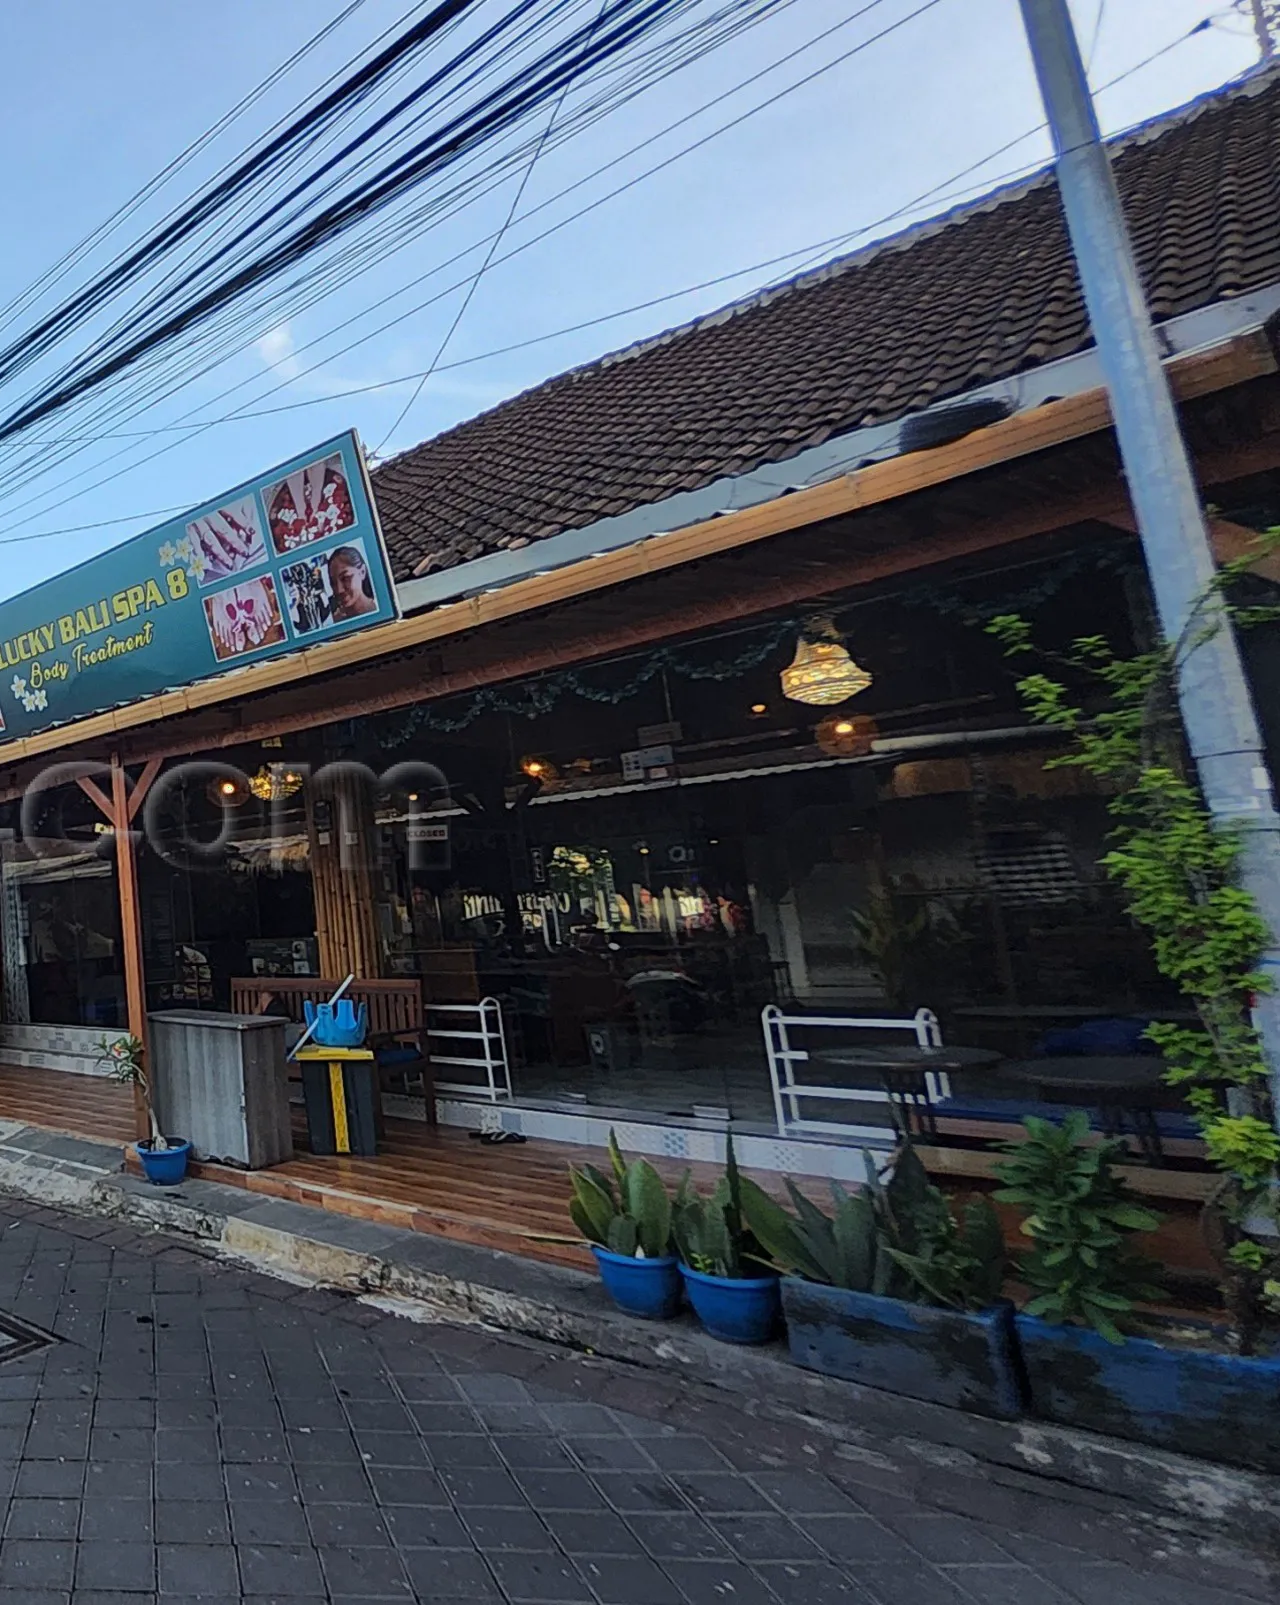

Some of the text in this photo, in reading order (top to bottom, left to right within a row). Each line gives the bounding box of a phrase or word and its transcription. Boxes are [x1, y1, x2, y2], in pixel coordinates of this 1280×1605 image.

[56, 598, 113, 645] BALI
[111, 577, 167, 623] SPA
[166, 566, 189, 601] 8
[30, 620, 154, 688] Body Treatment
